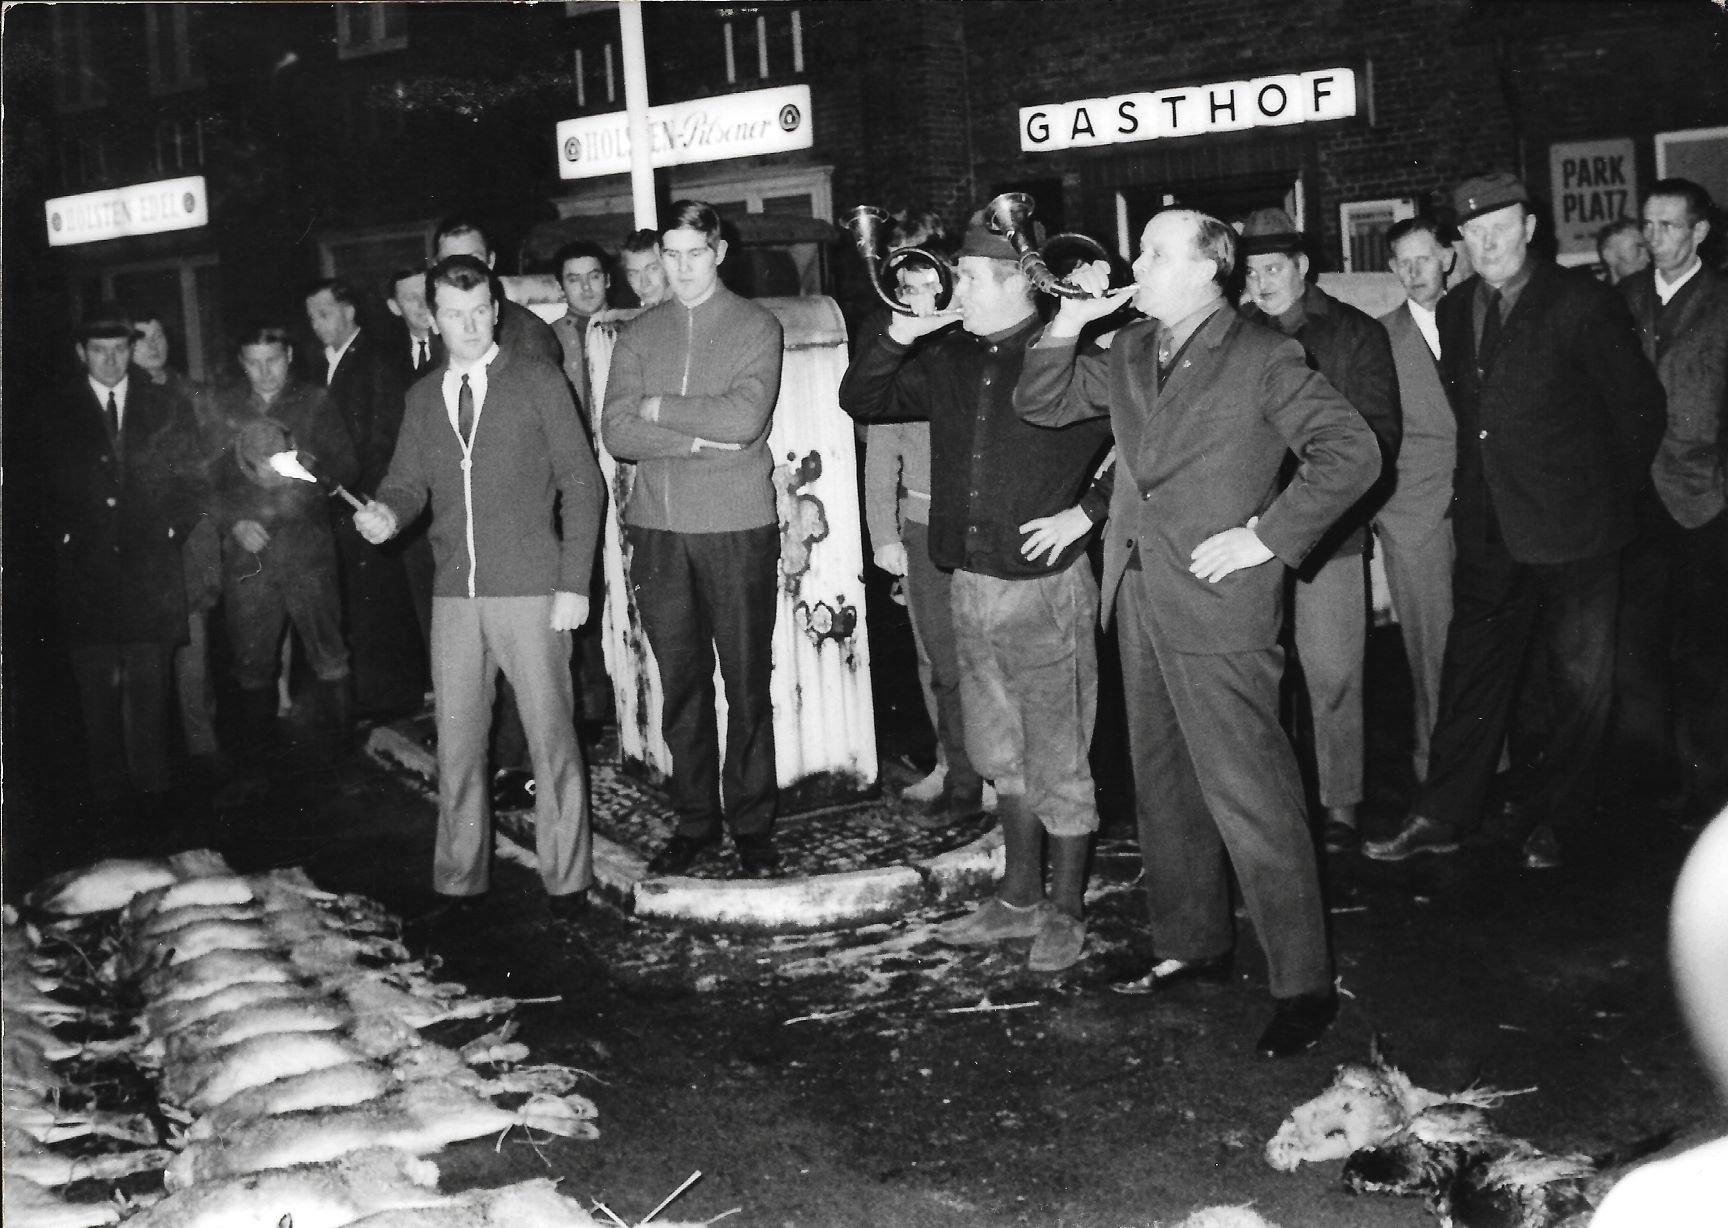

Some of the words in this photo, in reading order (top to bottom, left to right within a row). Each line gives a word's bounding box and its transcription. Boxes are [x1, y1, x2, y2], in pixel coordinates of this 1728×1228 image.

[1026, 76, 1334, 143] GASTHOF
[1562, 155, 1625, 189] PARK
[1563, 189, 1628, 223] PLATZ
